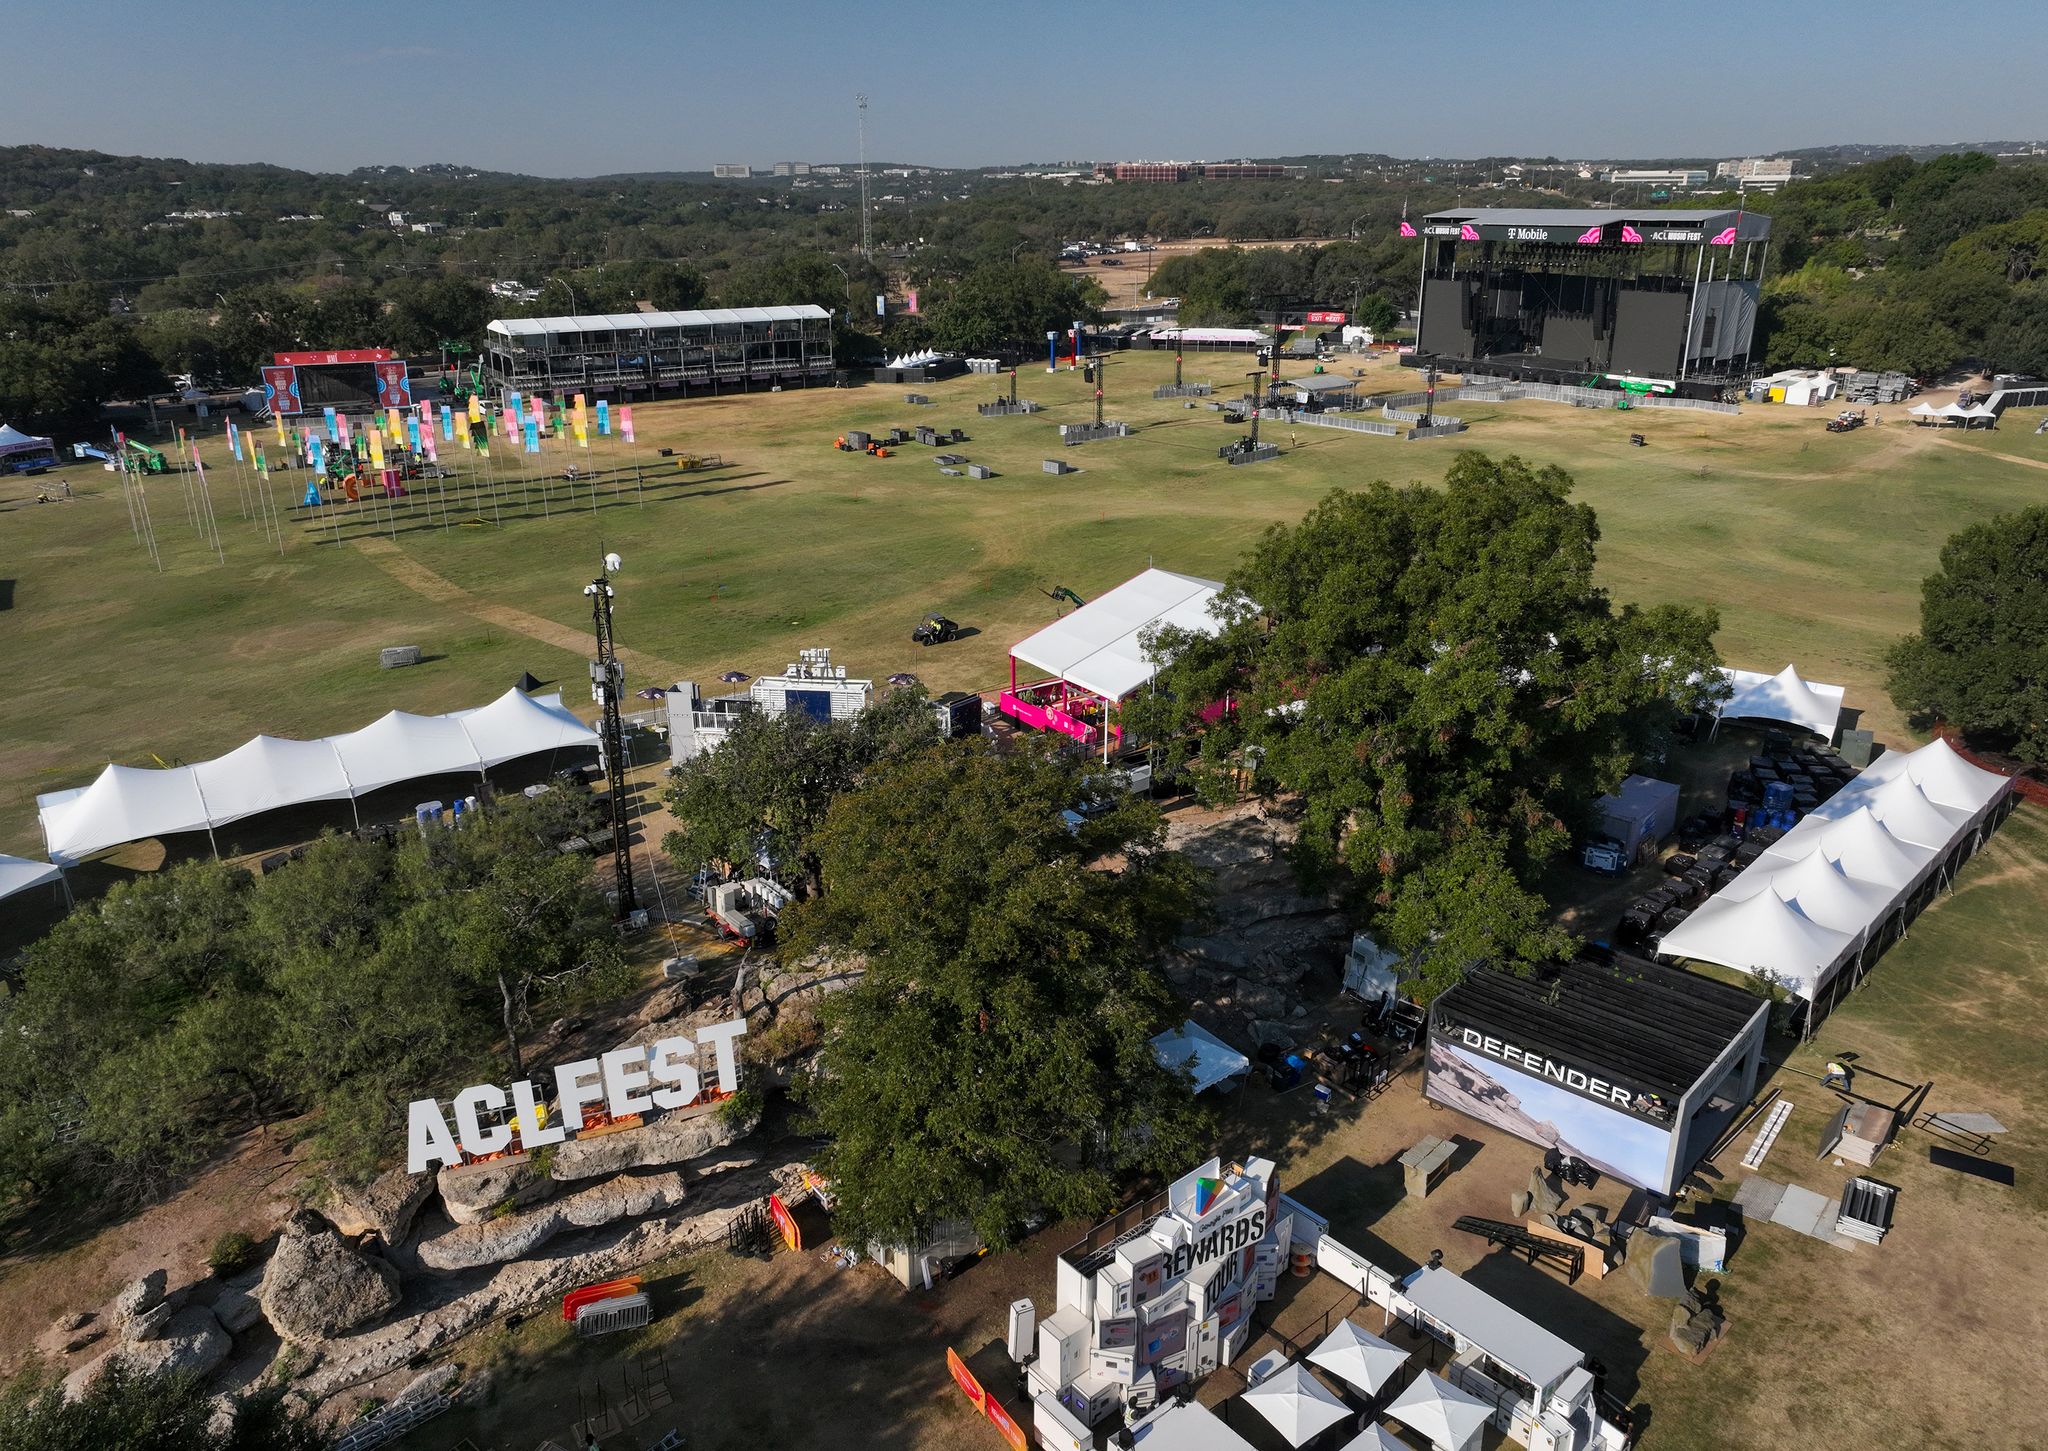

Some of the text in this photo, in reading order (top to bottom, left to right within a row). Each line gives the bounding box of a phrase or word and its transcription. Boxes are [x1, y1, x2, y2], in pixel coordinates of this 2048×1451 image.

[1517, 227, 1548, 240] Mobile
[1687, 232, 1701, 241] FEST
[408, 1018, 747, 1174] ACLFEST
[1462, 1027, 1631, 1109] DEFENDER
[1163, 1210, 1265, 1280] REWARDS
[1199, 1207, 1235, 1233] Google Play
[1204, 1251, 1238, 1313] TOUR
